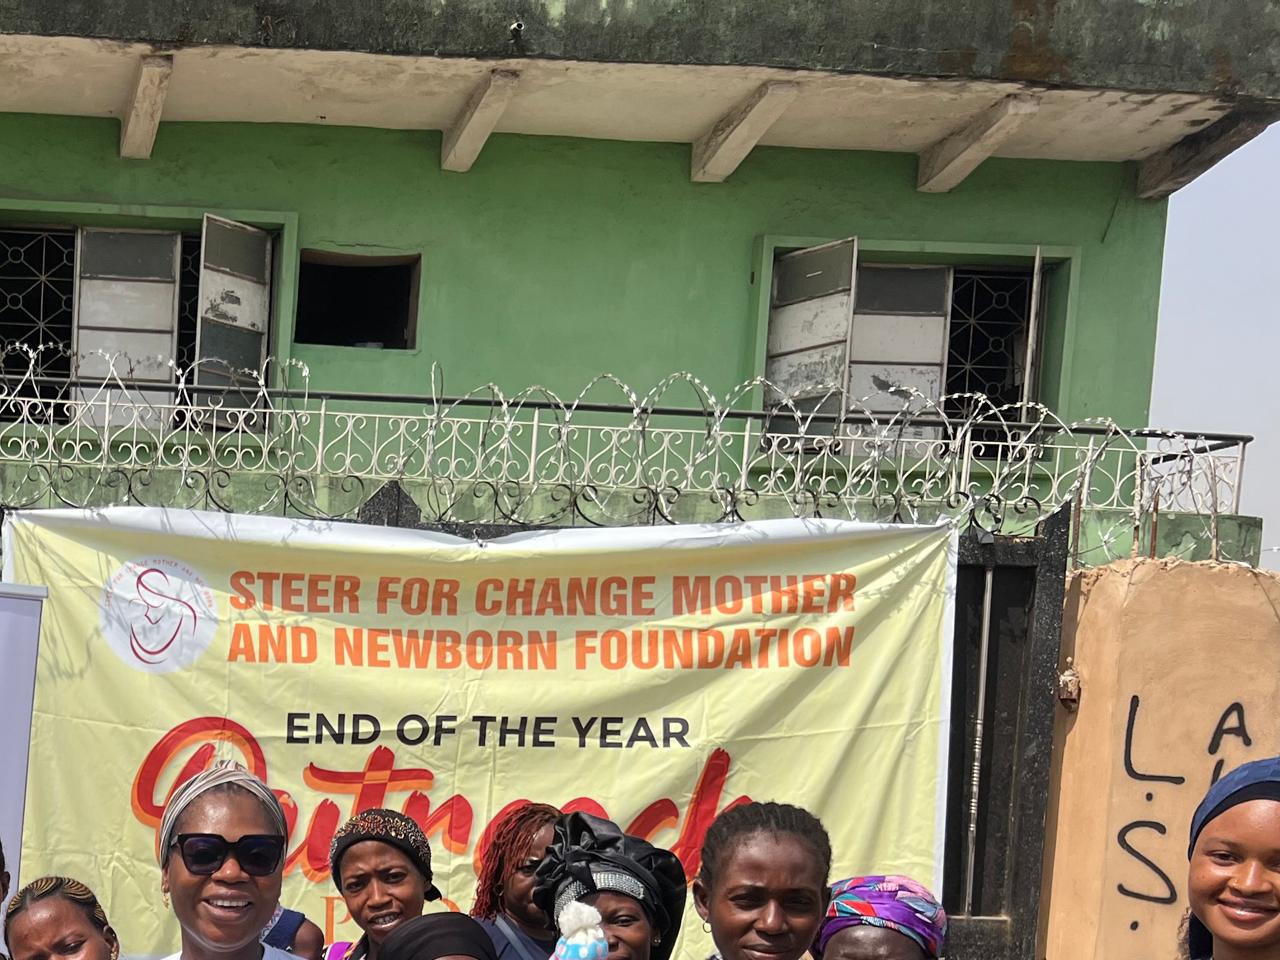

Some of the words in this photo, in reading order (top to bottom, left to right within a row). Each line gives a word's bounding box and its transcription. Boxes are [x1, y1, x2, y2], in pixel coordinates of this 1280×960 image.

[229, 570, 361, 613] STEER
[376, 576, 460, 616] FOR
[475, 576, 656, 616] CHANGE
[672, 572, 857, 616] MOTHER
[227, 623, 318, 664] AND
[334, 627, 557, 670] NEWBORN
[575, 626, 855, 670] FOUNDATION
[286, 712, 381, 744] END
[396, 714, 458, 746] OF
[471, 715, 558, 747] THE
[571, 716, 691, 748] YEAR
